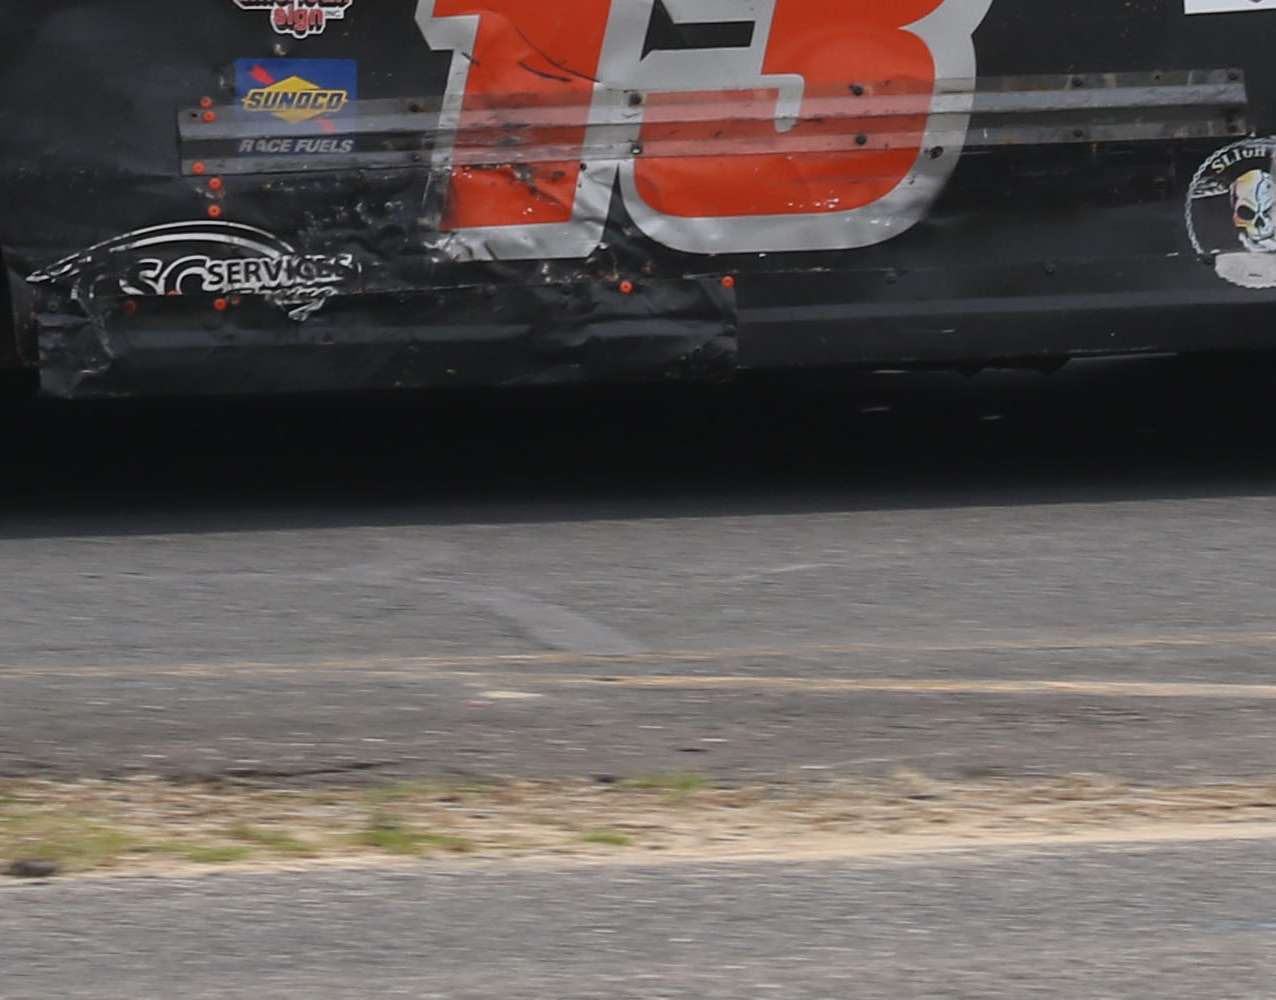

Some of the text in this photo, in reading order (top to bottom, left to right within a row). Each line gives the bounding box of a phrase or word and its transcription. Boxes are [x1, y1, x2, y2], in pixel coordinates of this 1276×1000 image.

[272, 4, 326, 37] sign
[243, 90, 346, 111] SUNOCO
[238, 139, 354, 153] RACE FUELS
